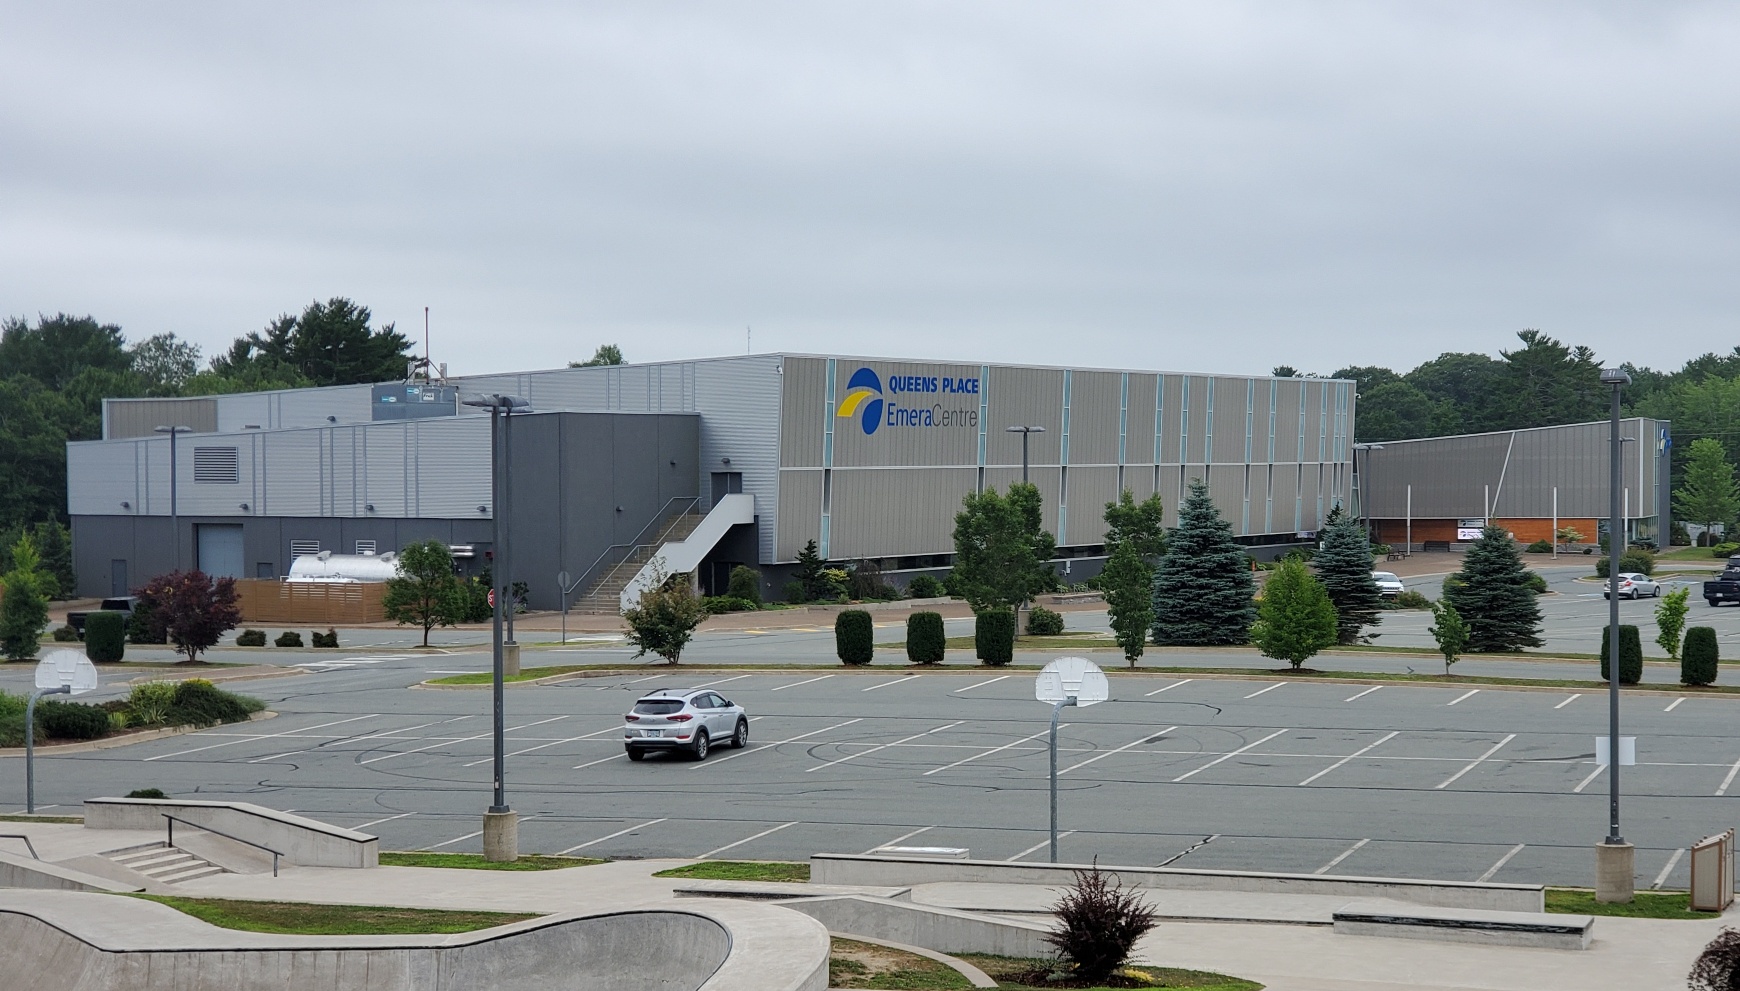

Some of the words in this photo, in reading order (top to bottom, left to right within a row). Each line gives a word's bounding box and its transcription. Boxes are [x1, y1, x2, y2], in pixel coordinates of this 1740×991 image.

[889, 376, 938, 394] QUEENS
[942, 377, 979, 394] PLACE
[887, 403, 978, 427] EmeraCentre
